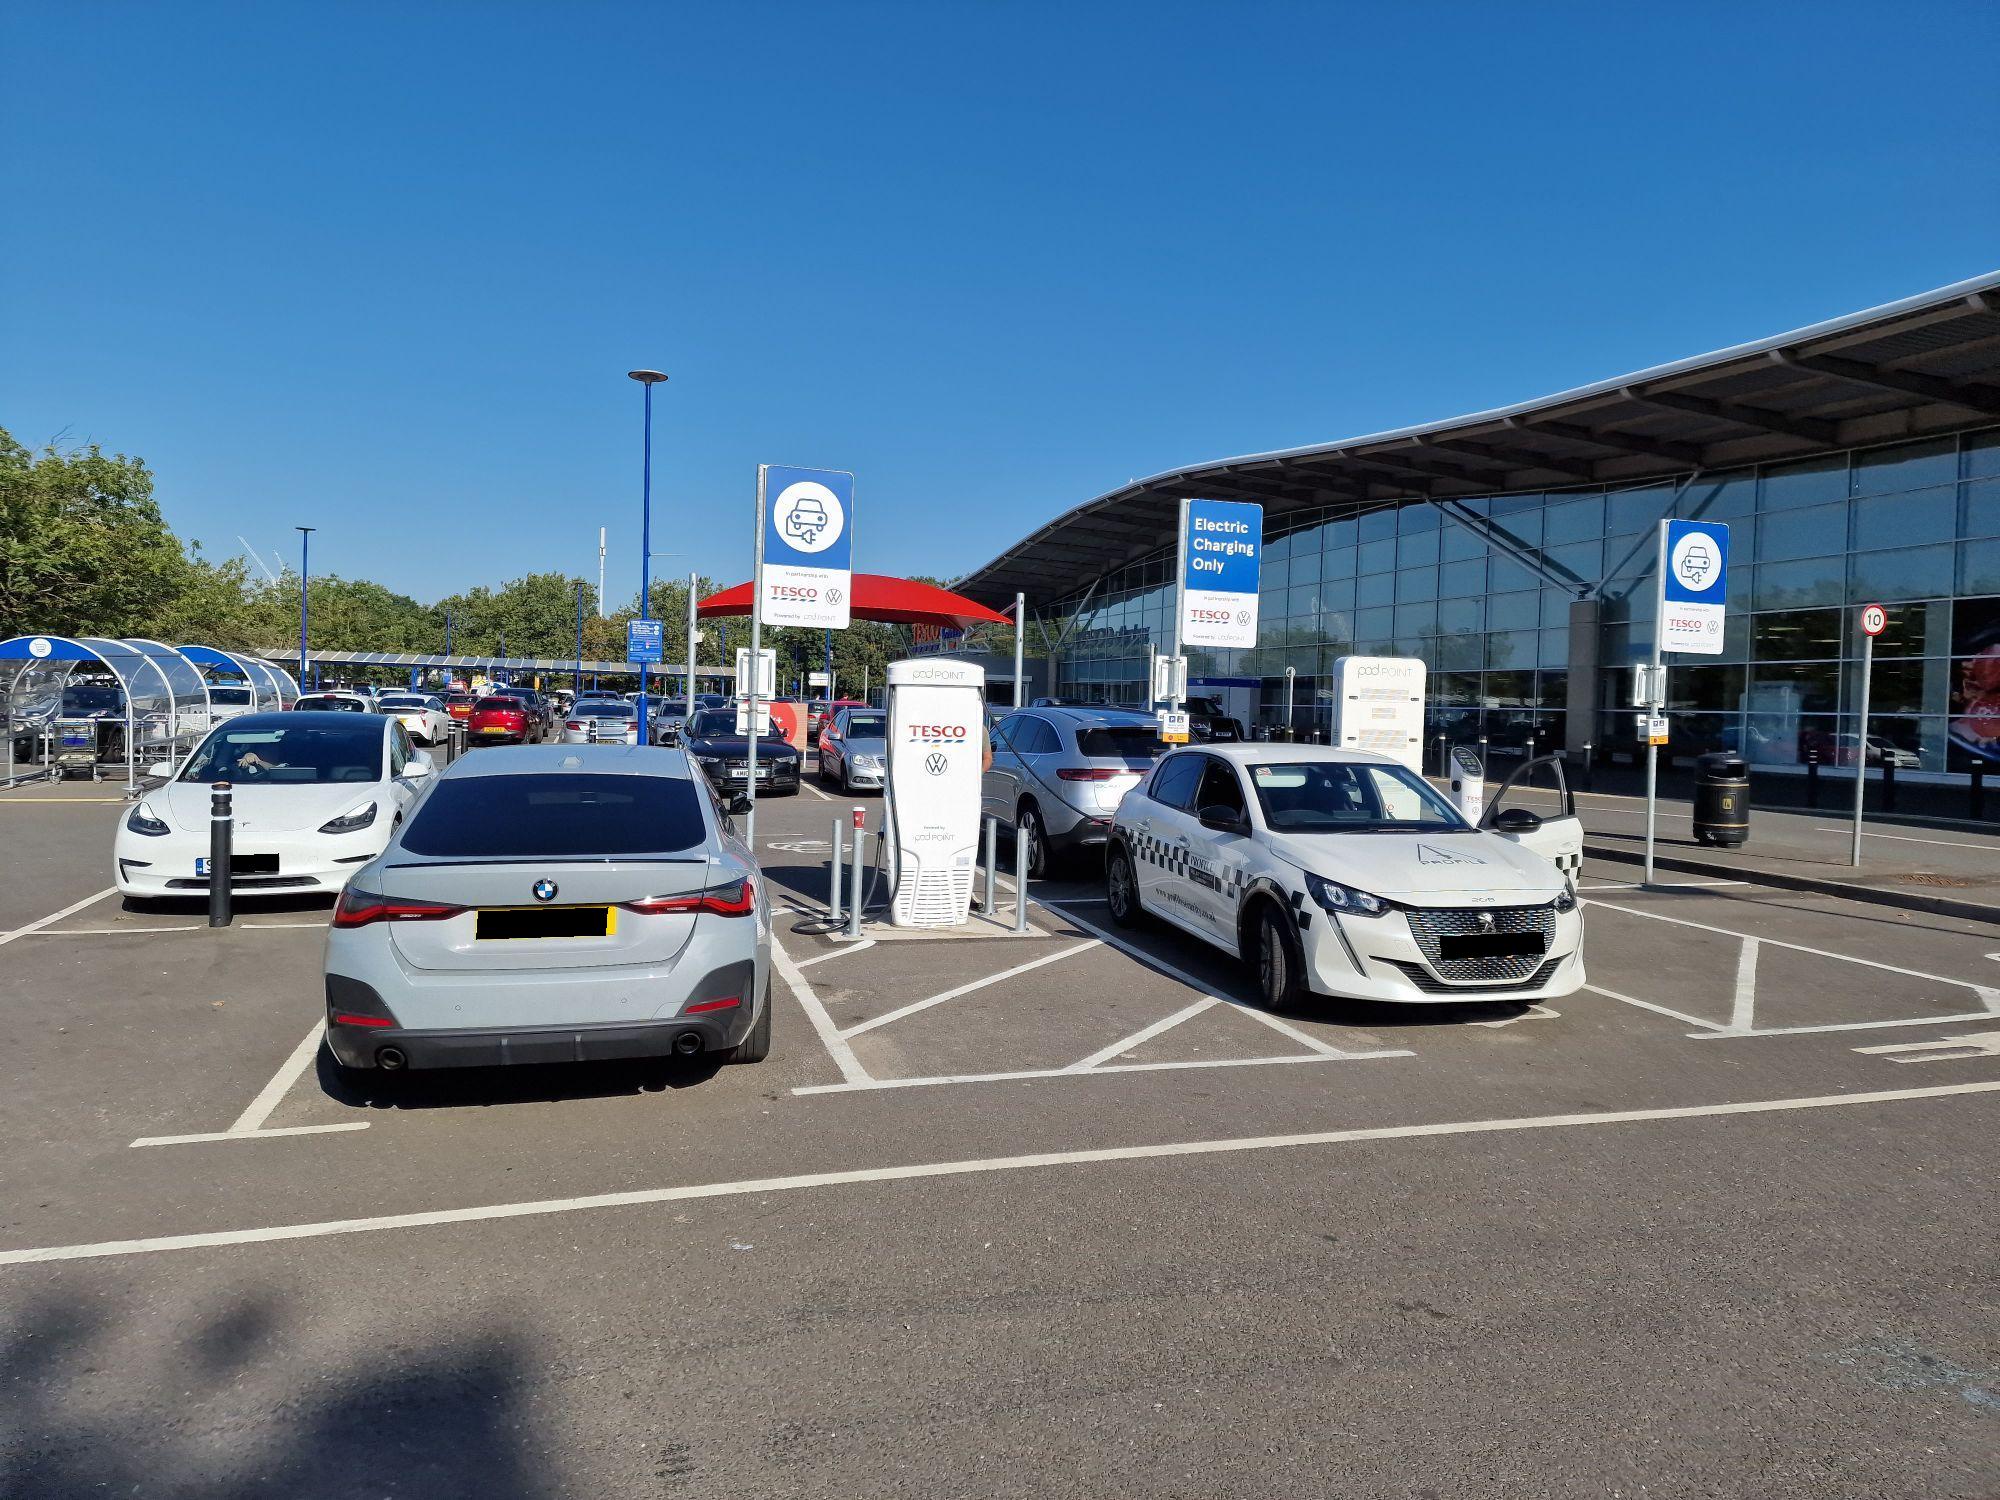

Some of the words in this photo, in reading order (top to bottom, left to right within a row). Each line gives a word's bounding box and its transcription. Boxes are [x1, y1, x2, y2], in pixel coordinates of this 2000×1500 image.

[1195, 518, 1249, 534] Electric
[1193, 538, 1254, 557] Charging
[1192, 558, 1225, 575] Only
[770, 585, 818, 598] TESCO
[1190, 609, 1230, 620] TESCO
[1867, 613, 1881, 626] 10
[1668, 618, 1702, 629] TESCO
[912, 667, 934, 680] pod
[934, 670, 966, 680] POINT
[1357, 664, 1380, 679] pod
[1382, 667, 1413, 678] POINT
[908, 724, 966, 738] TESCO
